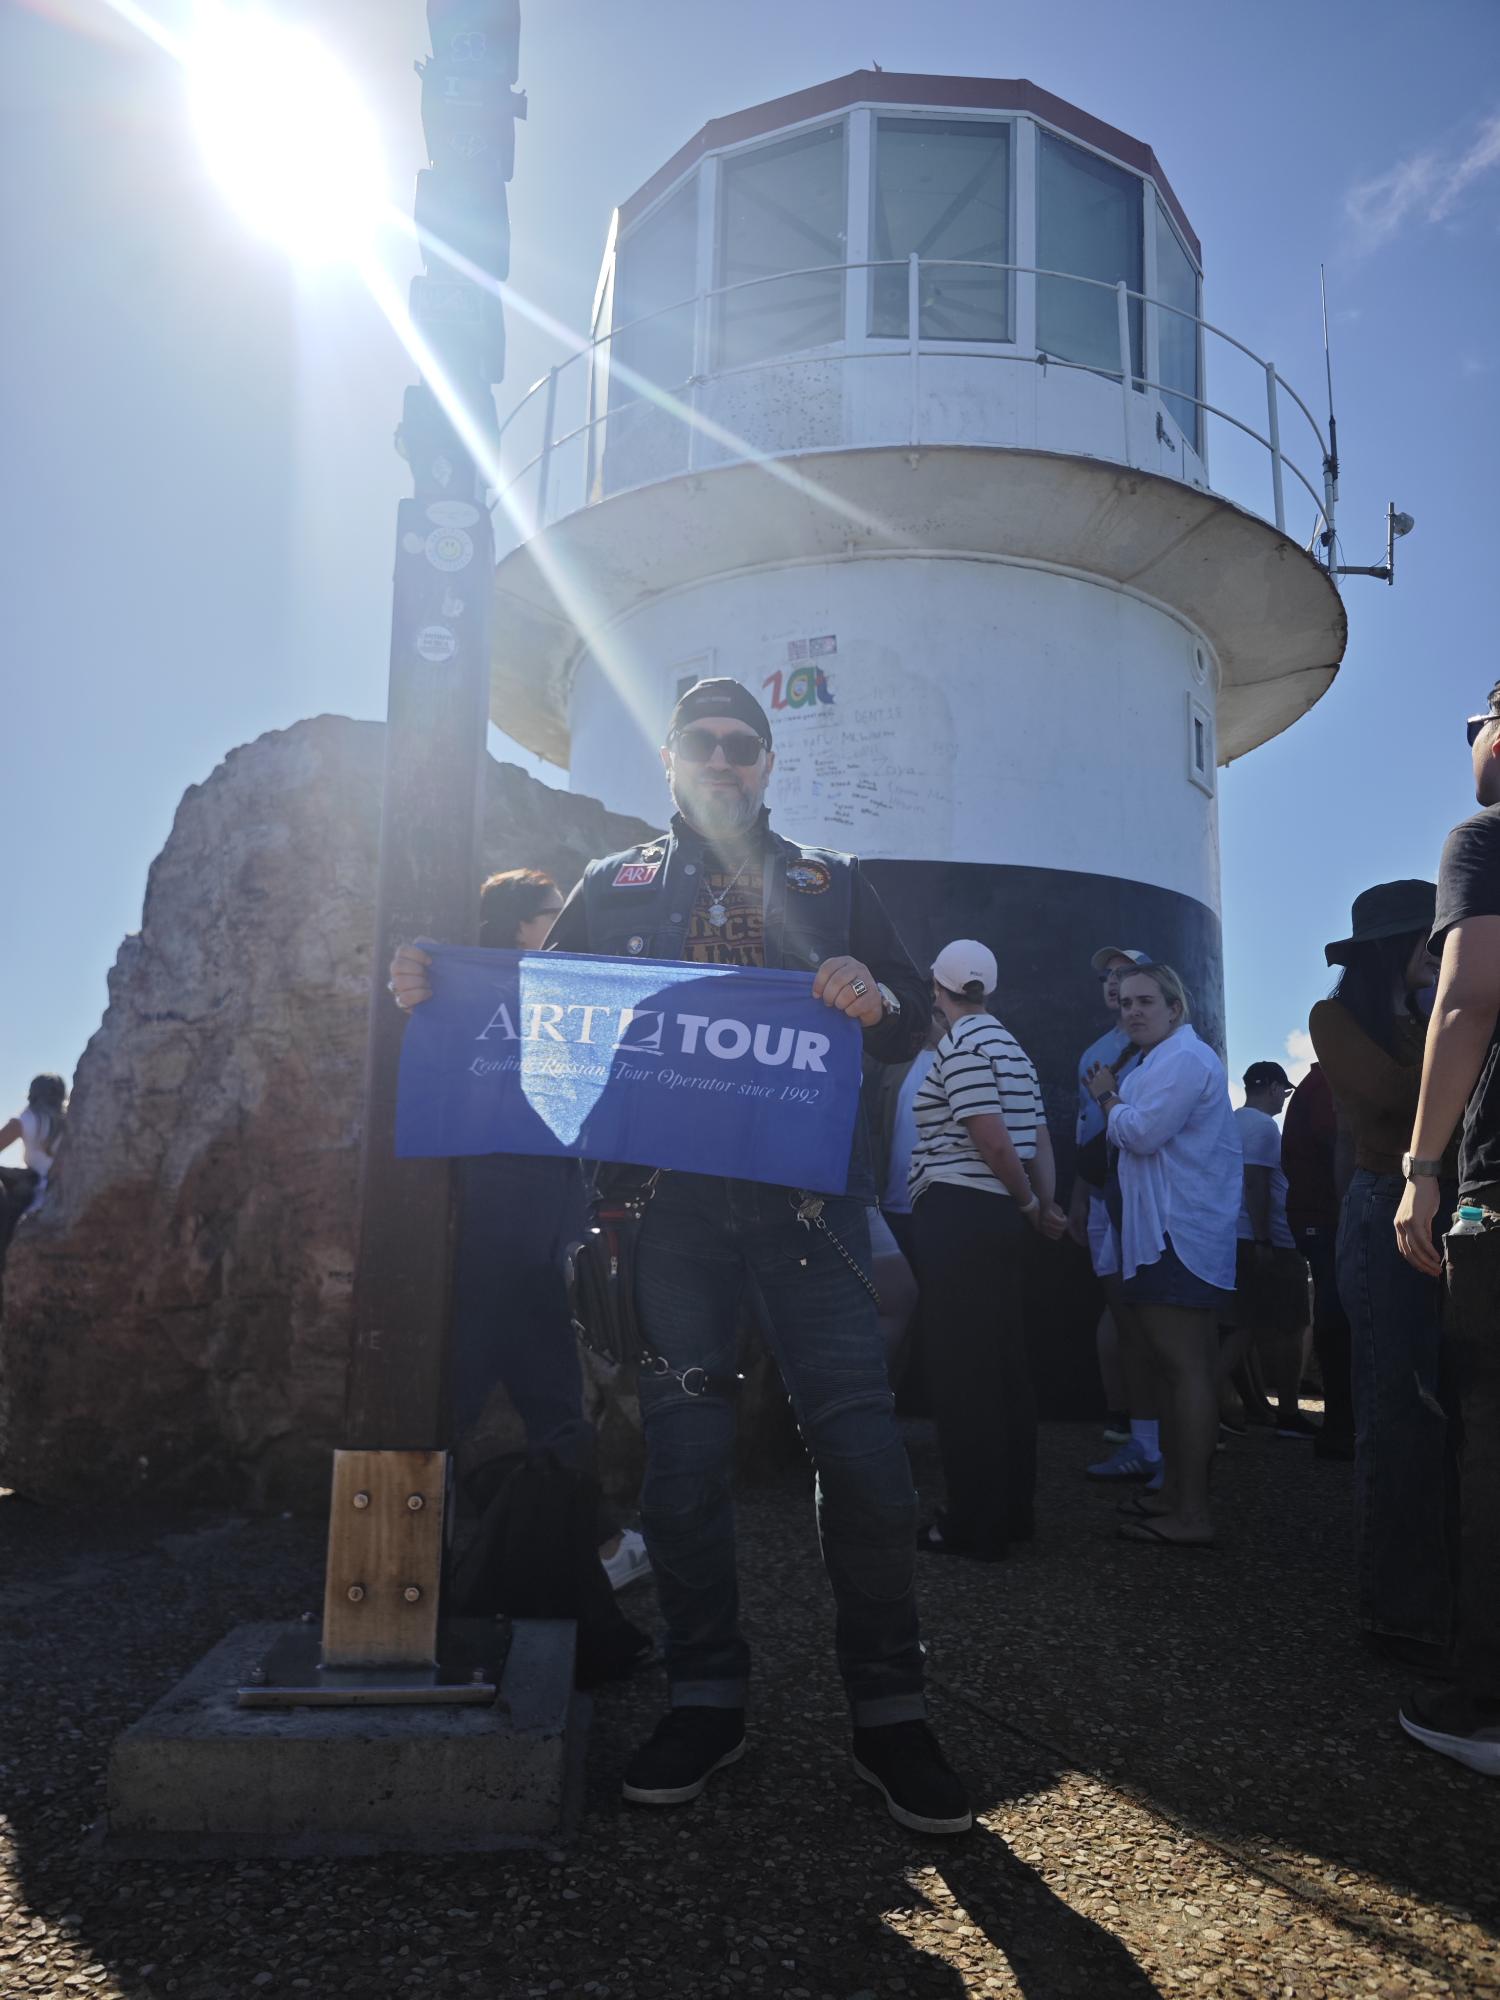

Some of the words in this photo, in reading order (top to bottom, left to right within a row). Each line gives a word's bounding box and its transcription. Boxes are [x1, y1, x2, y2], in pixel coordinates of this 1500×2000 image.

[618, 865, 656, 883] ART
[475, 1002, 609, 1045] ART
[677, 1013, 830, 1073] TOUR
[613, 1060, 654, 1082] Tour
[657, 1068, 736, 1093] Operator
[737, 1080, 776, 1099] since
[778, 1086, 821, 1105] 1992
